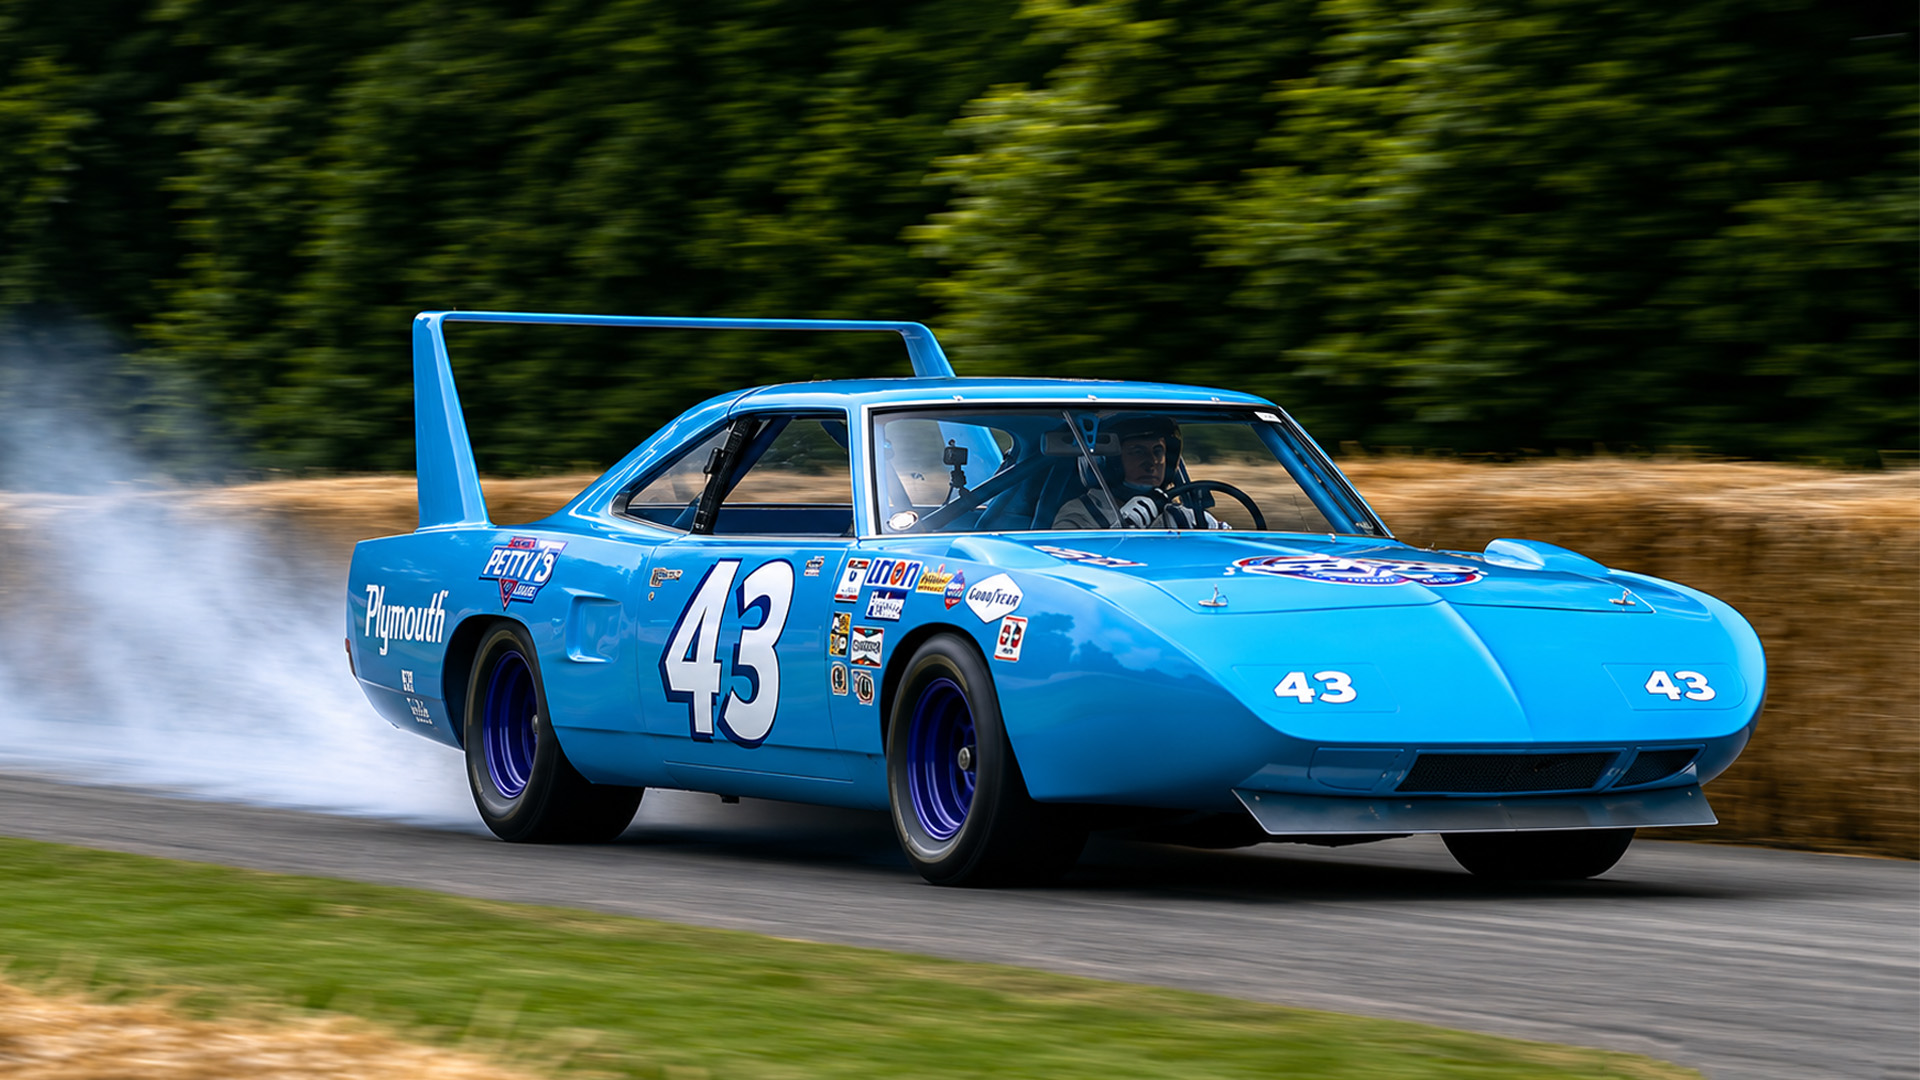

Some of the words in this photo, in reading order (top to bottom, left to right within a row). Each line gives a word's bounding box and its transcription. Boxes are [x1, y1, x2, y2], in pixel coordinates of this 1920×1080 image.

[365, 584, 449, 656] Plymouth
[659, 557, 795, 748] 43
[1273, 670, 1358, 704] 43
[1644, 670, 1716, 701] 43
